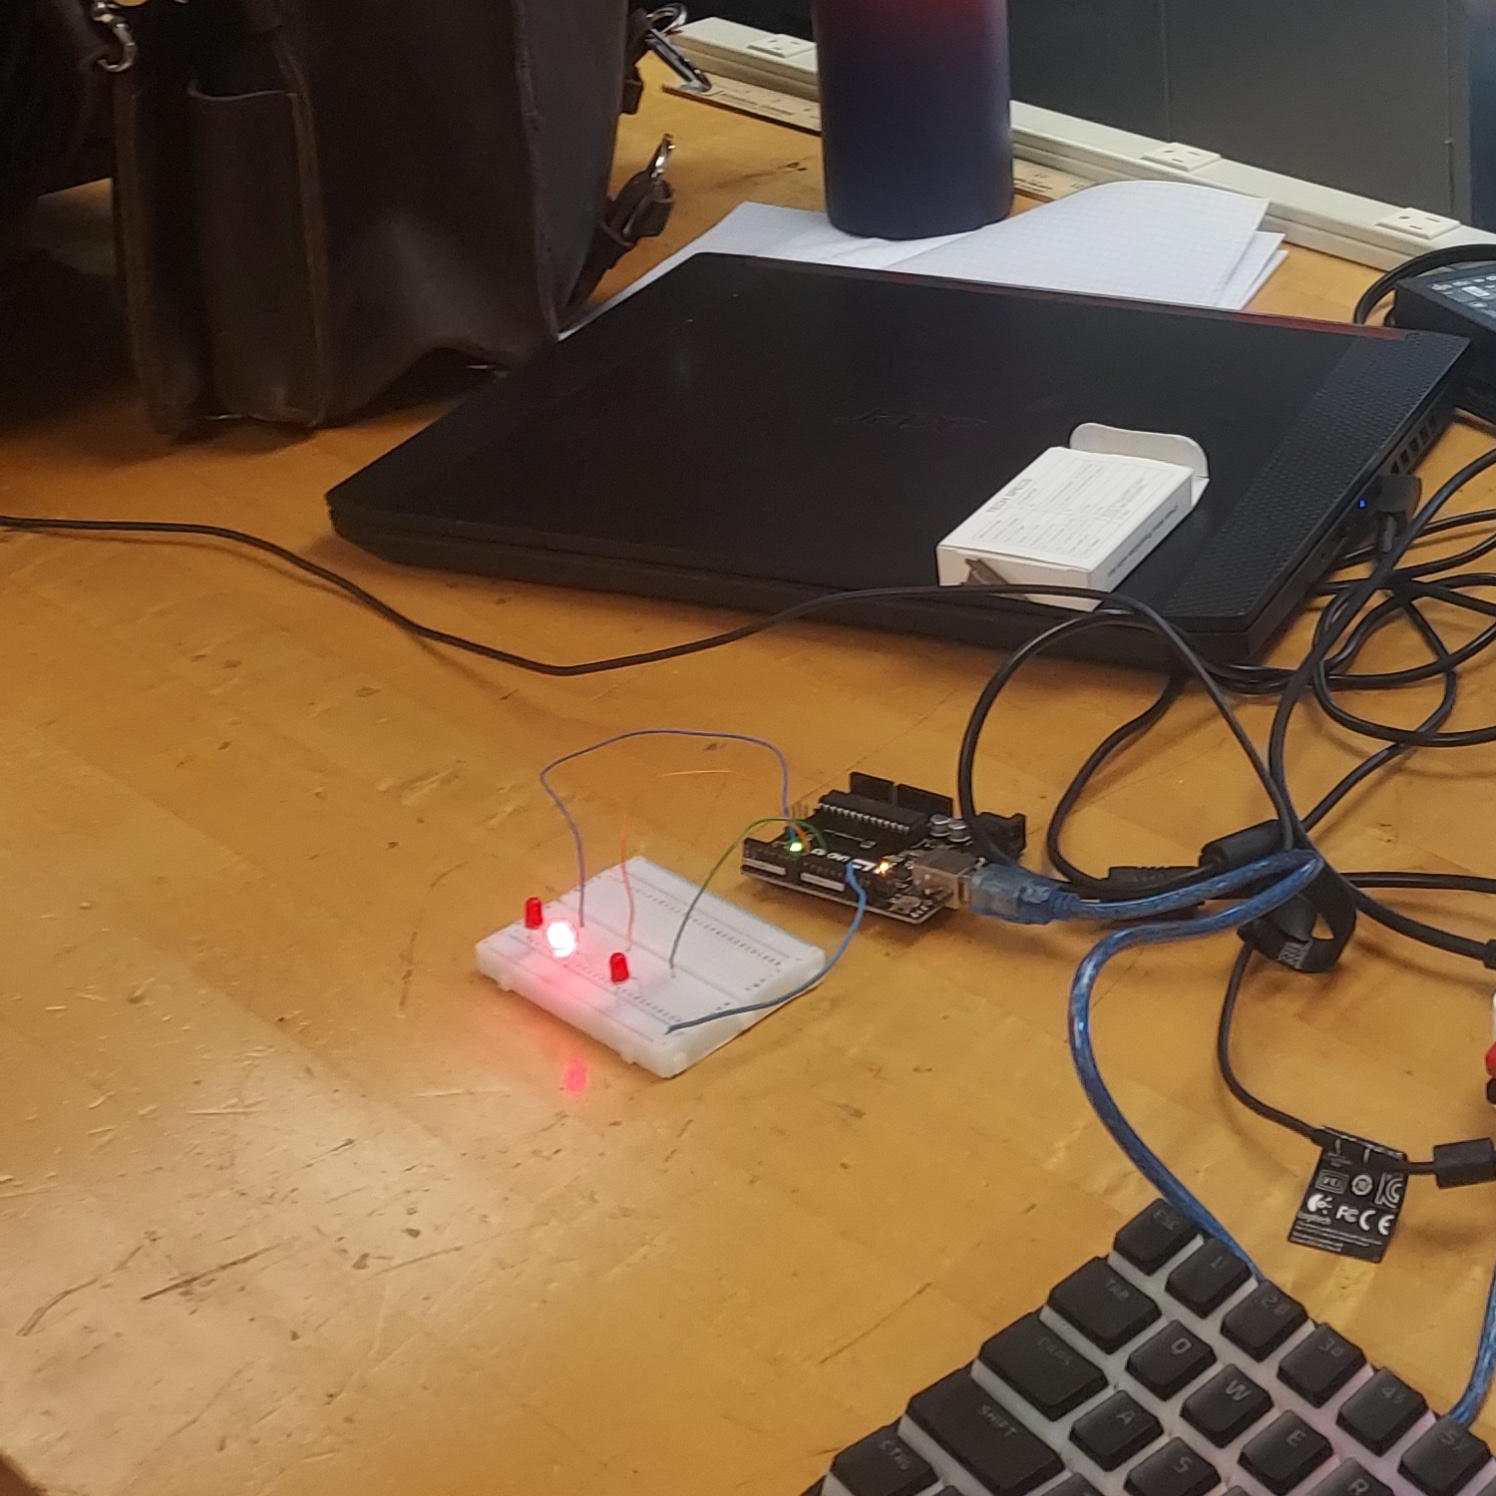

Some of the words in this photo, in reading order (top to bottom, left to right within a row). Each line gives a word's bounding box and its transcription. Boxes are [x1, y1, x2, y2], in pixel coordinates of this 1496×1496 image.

[1225, 1379, 1251, 1401] W
[1116, 1411, 1136, 1425] A
[1286, 1429, 1307, 1447] E
[1173, 1457, 1193, 1474] S
[1348, 1479, 1370, 1496] R
